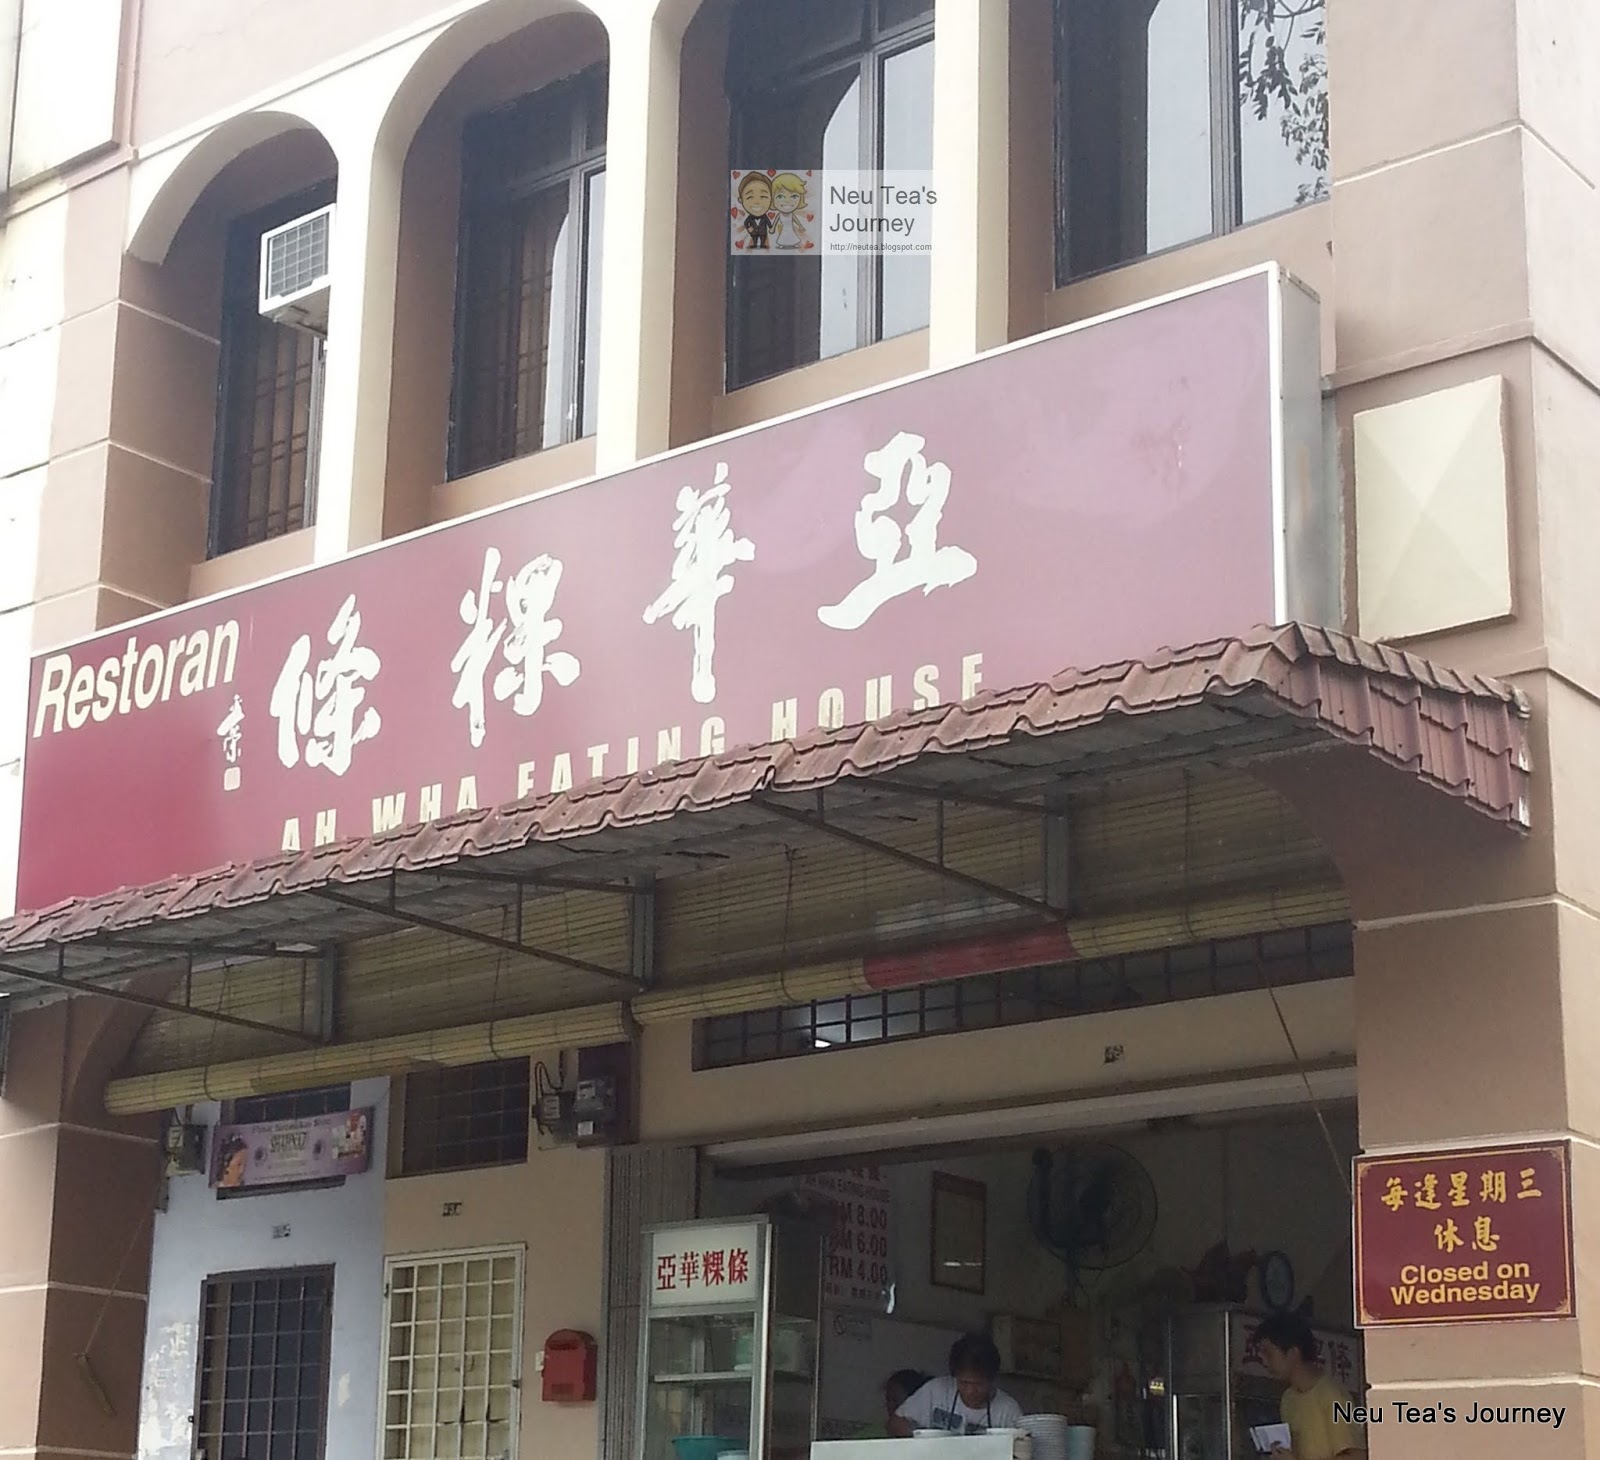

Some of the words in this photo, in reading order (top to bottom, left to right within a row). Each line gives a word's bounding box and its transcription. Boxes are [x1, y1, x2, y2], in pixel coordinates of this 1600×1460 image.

[33, 619, 240, 737] Restoran
[281, 809, 337, 851] AH
[372, 775, 478, 834] WHA
[1381, 1167, 1542, 1211] 每逢星期三
[857, 1204, 887, 1229] 8.00
[857, 1232, 887, 1257] 6.00
[1434, 1216, 1500, 1252] 休息
[656, 1248, 749, 1291] 亞華粿條
[857, 1260, 888, 1285] 4.00
[1401, 1261, 1489, 1284] Closed
[1497, 1262, 1530, 1278] on
[1391, 1281, 1540, 1305] Wednesday
